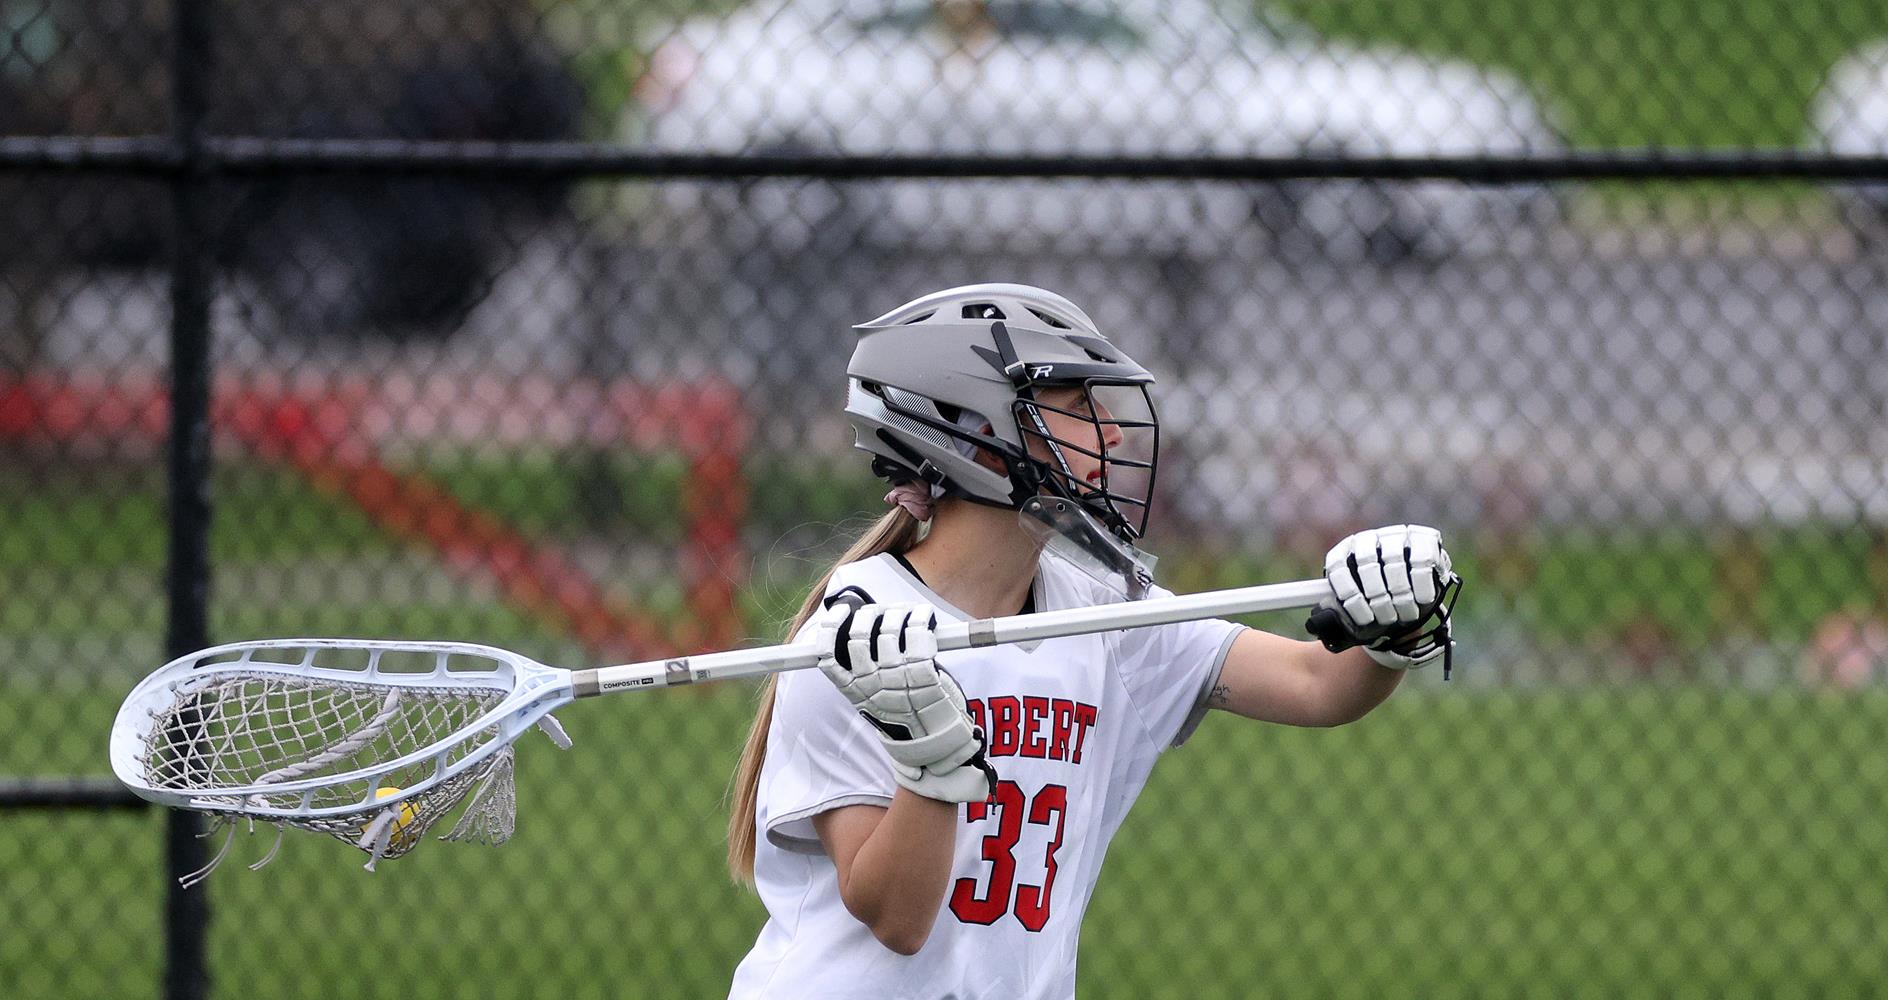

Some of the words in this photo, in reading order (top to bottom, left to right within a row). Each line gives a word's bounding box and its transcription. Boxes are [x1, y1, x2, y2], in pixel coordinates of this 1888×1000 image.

[603, 679, 641, 689] COMPOSITE
[642, 677, 654, 685] PRO
[948, 779, 1068, 933] 33
